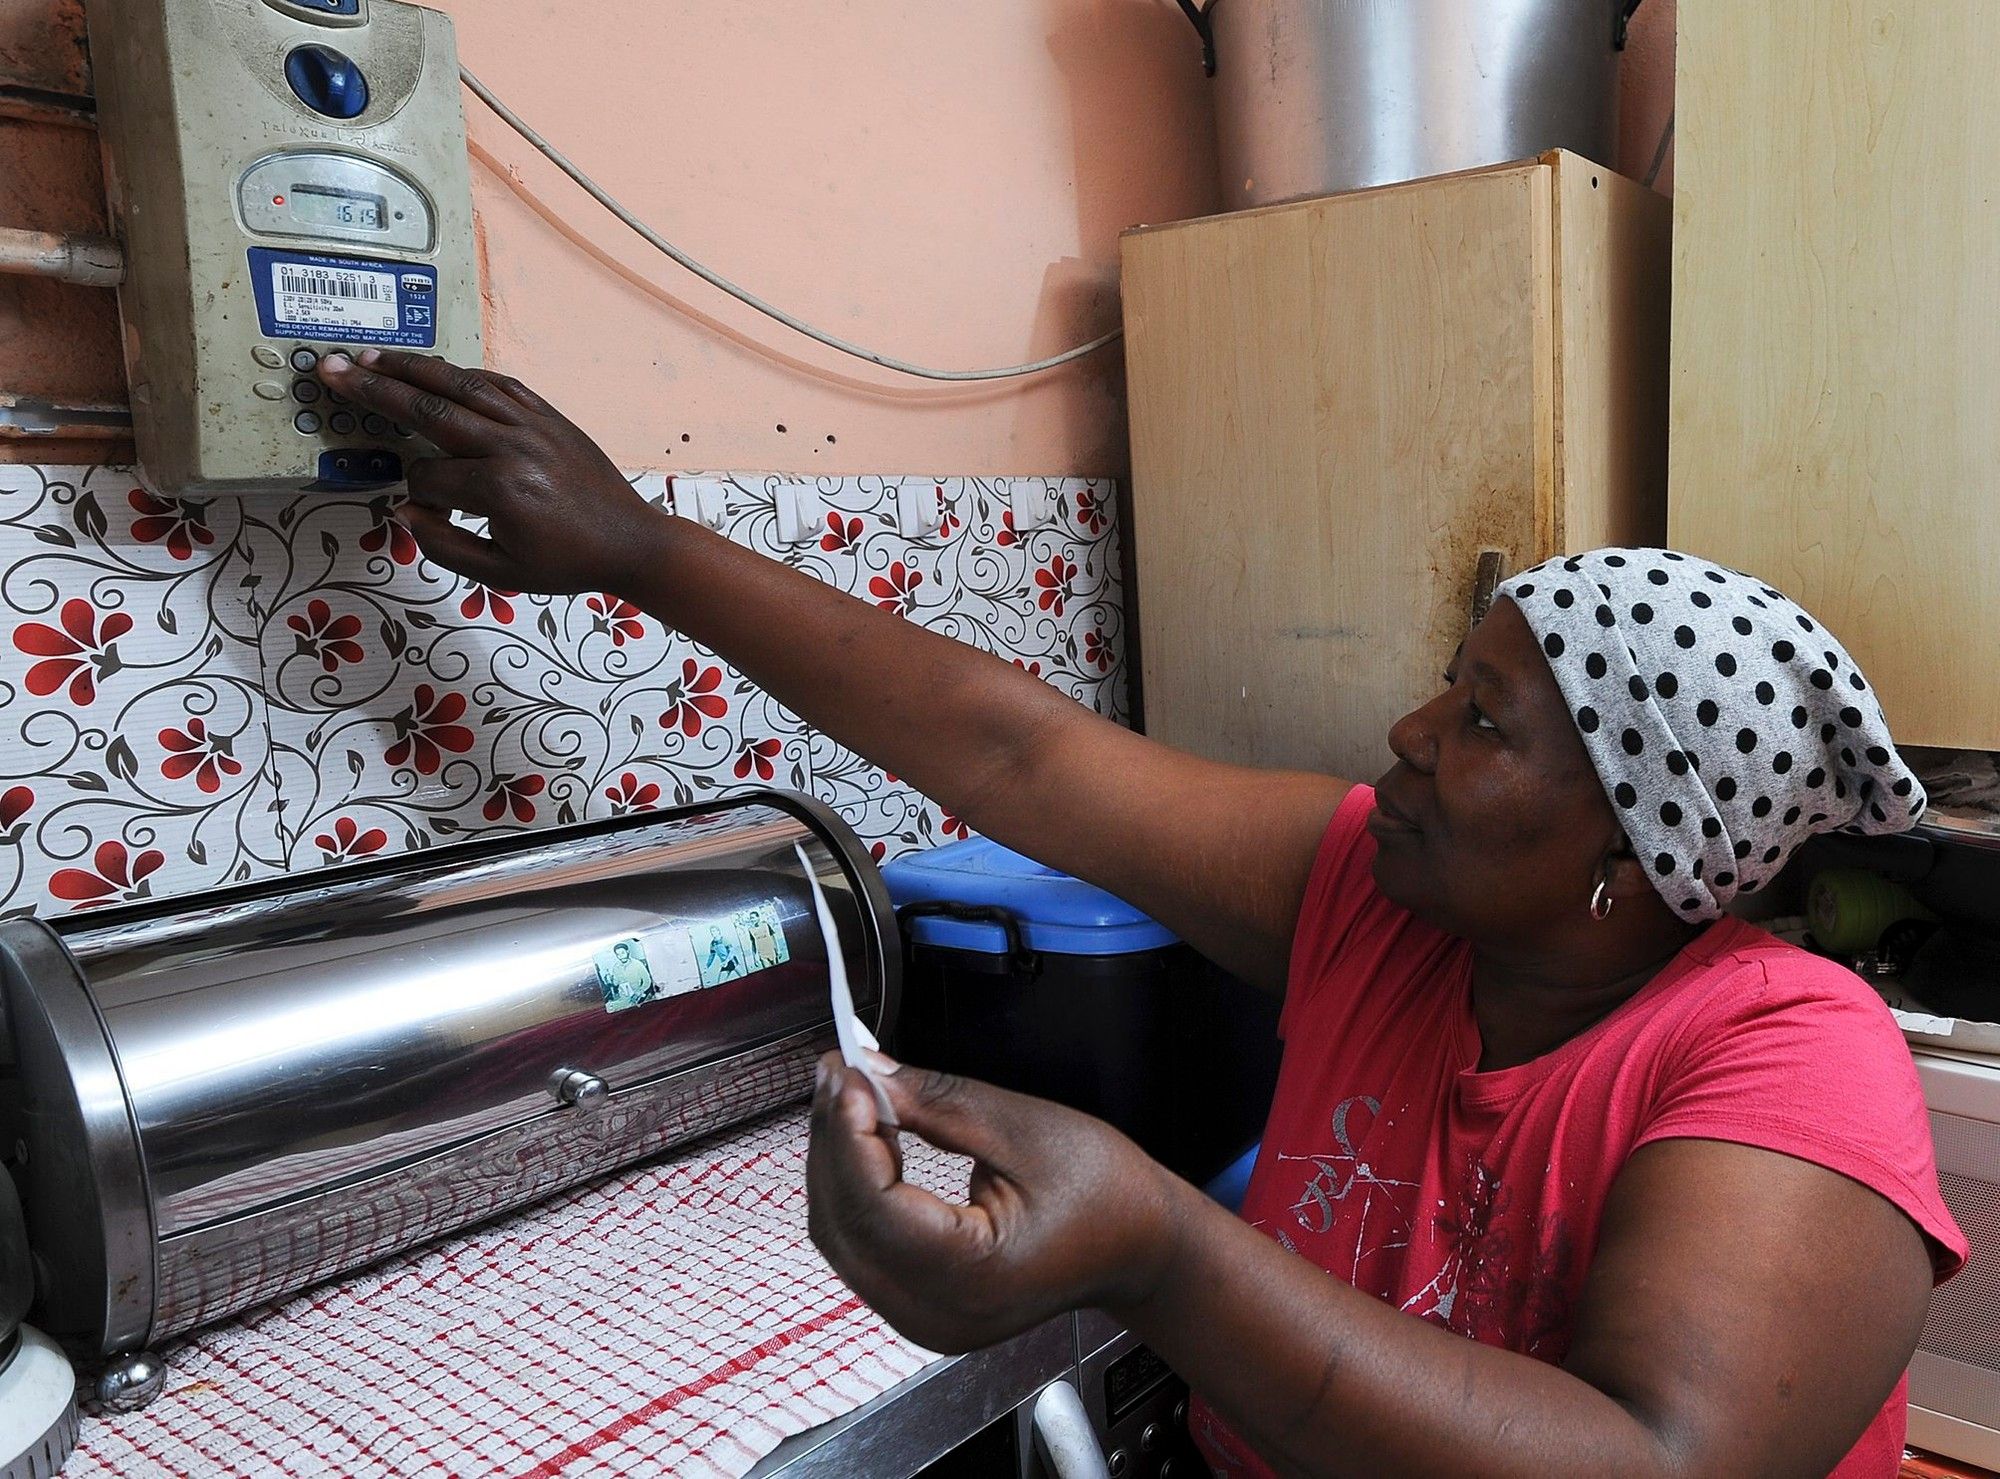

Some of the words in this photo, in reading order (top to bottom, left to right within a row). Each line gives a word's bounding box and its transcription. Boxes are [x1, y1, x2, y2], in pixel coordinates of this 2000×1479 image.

[280, 266, 294, 276] 01
[301, 268, 330, 280] 3183
[336, 271, 362, 283] 5251
[368, 275, 376, 284] 3
[304, 331, 344, 339] AUTHORITY
[318, 325, 350, 333] REMAINS
[364, 329, 400, 337] PROPERTY
